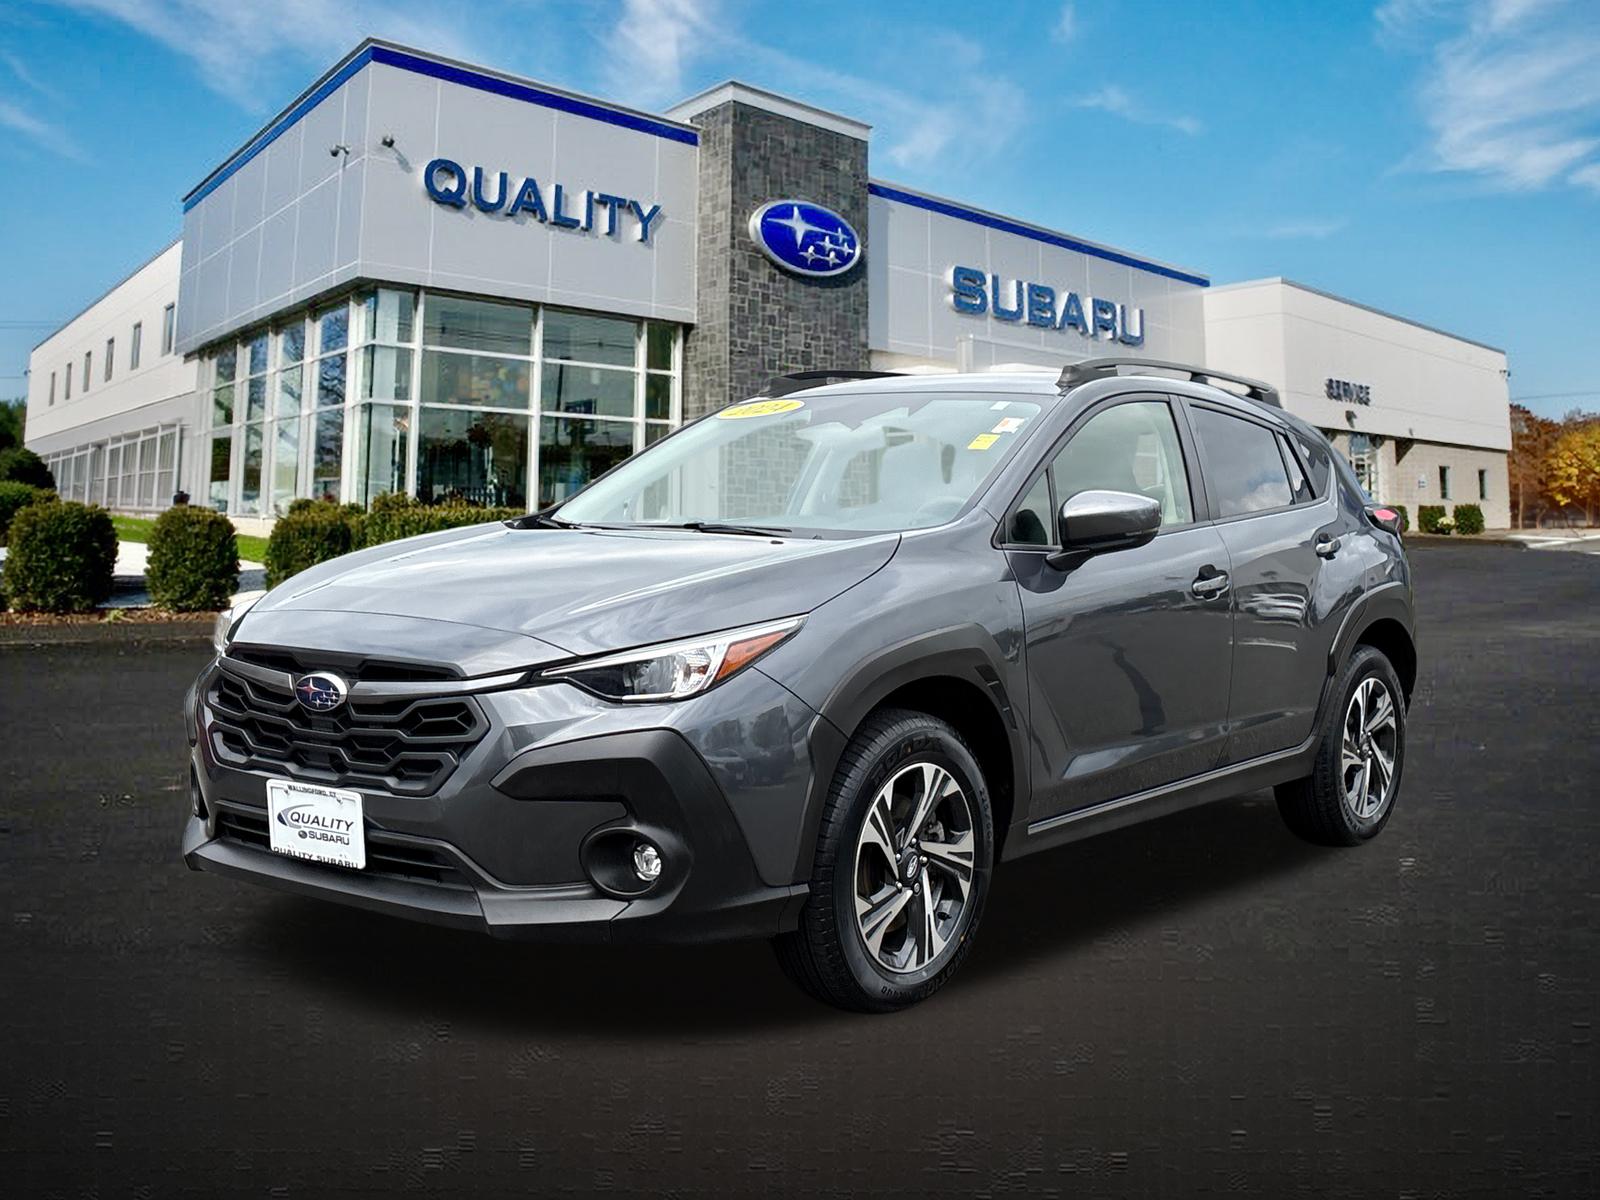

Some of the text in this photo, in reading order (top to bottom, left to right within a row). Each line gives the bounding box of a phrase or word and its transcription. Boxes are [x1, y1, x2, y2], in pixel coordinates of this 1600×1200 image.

[423, 158, 662, 243] QUALITY
[949, 265, 1145, 347] SUBARU
[1325, 378, 1371, 406] SERVICE
[290, 811, 354, 832] QUALITY
[308, 830, 350, 846] SUBARU
[273, 846, 359, 868] QUALITY SUBARU
